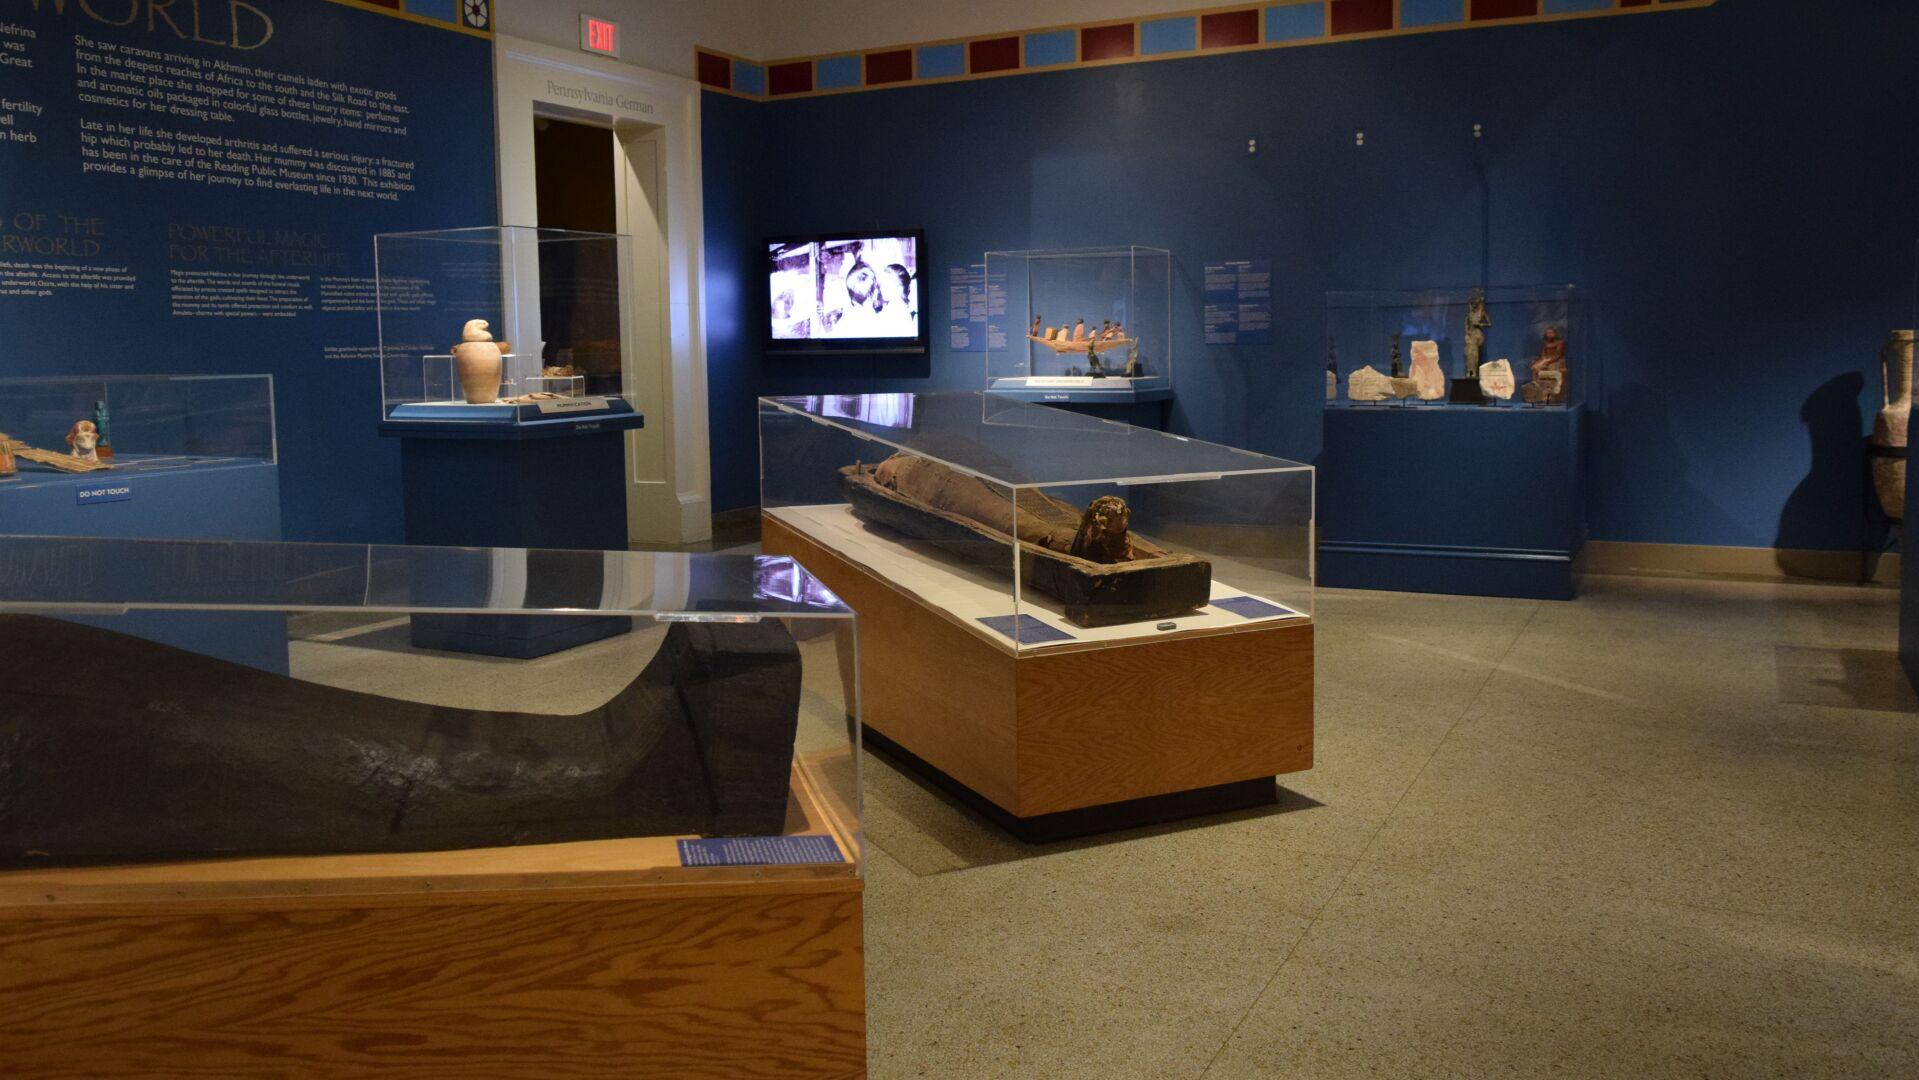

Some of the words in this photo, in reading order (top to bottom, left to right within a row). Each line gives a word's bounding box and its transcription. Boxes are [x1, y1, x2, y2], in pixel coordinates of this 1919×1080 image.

[2, 41, 26, 52] was
[589, 19, 615, 52] EXIT
[0, 52, 34, 68] Great
[75, 34, 94, 48] She
[98, 42, 116, 52] saw
[120, 45, 162, 59] caravans
[164, 52, 200, 69] arriving
[202, 57, 210, 68] in
[255, 66, 275, 79] their
[278, 73, 305, 84] camels
[307, 75, 328, 88] laden
[330, 81, 348, 92] with
[76, 47, 101, 62] from
[104, 53, 121, 66] the
[124, 56, 164, 74] deepest
[166, 66, 202, 79] reaches
[205, 71, 215, 81] of
[217, 72, 243, 86] Africa
[246, 78, 256, 88] to
[258, 79, 272, 91] the
[274, 85, 298, 95] south
[300, 88, 314, 98] and
[316, 89, 330, 100] the
[347, 94, 367, 107] Road
[369, 99, 378, 108] to
[379, 100, 392, 111] the
[76, 61, 87, 74] In
[90, 64, 107, 77] the
[110, 70, 146, 83] market
[148, 74, 174, 88] place
[176, 78, 192, 90] she
[195, 82, 234, 98] shopped
[236, 87, 249, 99] for
[252, 93, 275, 103] some
[278, 95, 286, 105] of
[288, 96, 310, 109] these
[312, 100, 338, 116] luxury
[2, 98, 43, 117] fertility
[77, 78, 96, 89] and
[100, 82, 144, 96] aromatic
[147, 87, 164, 99] oils
[166, 92, 209, 108] packaged
[212, 97, 220, 107] in
[223, 99, 257, 113] colorful
[259, 104, 279, 117] glass
[364, 121, 392, 133] mirrors
[394, 126, 407, 135] and
[78, 93, 130, 107] cosmetics
[132, 97, 147, 110] for
[150, 100, 167, 112] her
[170, 103, 208, 121] dressing
[547, 80, 613, 105] Pennsylvania
[616, 95, 654, 114] German
[0, 114, 14, 125] ell
[10, 130, 37, 142] herb
[80, 117, 103, 131] Late
[106, 121, 116, 132] in
[119, 122, 136, 135] her
[139, 124, 153, 137] life
[156, 128, 173, 139] she
[176, 129, 222, 147] developed
[224, 137, 260, 150] arthritis
[262, 142, 278, 152] and
[280, 144, 312, 156] suffered
[322, 150, 349, 161] serious
[81, 131, 98, 148] hip
[100, 134, 130, 147] which
[134, 139, 176, 156] probably
[178, 142, 192, 154] led
[195, 145, 206, 156] to
[208, 146, 223, 158] her
[255, 152, 272, 163] Her
[274, 157, 307, 171] mummy
[308, 161, 325, 170] was
[326, 160, 367, 175] discovered
[369, 166, 376, 176] in
[398, 171, 411, 180] and
[82, 145, 100, 158] has
[102, 147, 128, 160] been
[130, 151, 140, 162] in
[142, 152, 158, 164] the
[162, 157, 182, 166] care
[184, 157, 194, 168] of
[197, 158, 212, 169] the
[214, 159, 250, 177] Reading
[252, 164, 277, 176] Public
[279, 167, 314, 180] Museum
[316, 172, 336, 183] since
[362, 176, 378, 188] This
[380, 180, 416, 192] exhibition
[83, 161, 128, 174] provides
[130, 166, 136, 174] a
[138, 164, 175, 181] glimpse
[177, 169, 188, 180] of
[190, 169, 206, 181] her
[208, 172, 242, 188] journey
[244, 176, 254, 186] to
[256, 176, 273, 188] find
[274, 180, 318, 196] everlasting
[320, 183, 332, 194] life
[334, 185, 341, 195] in
[342, 186, 356, 196] the
[358, 190, 375, 198] next
[14, 212, 48, 231] OF
[58, 215, 104, 236] THE
[3, 234, 100, 256] RWORLD
[169, 244, 208, 262] FOR
[213, 246, 252, 264] THE
